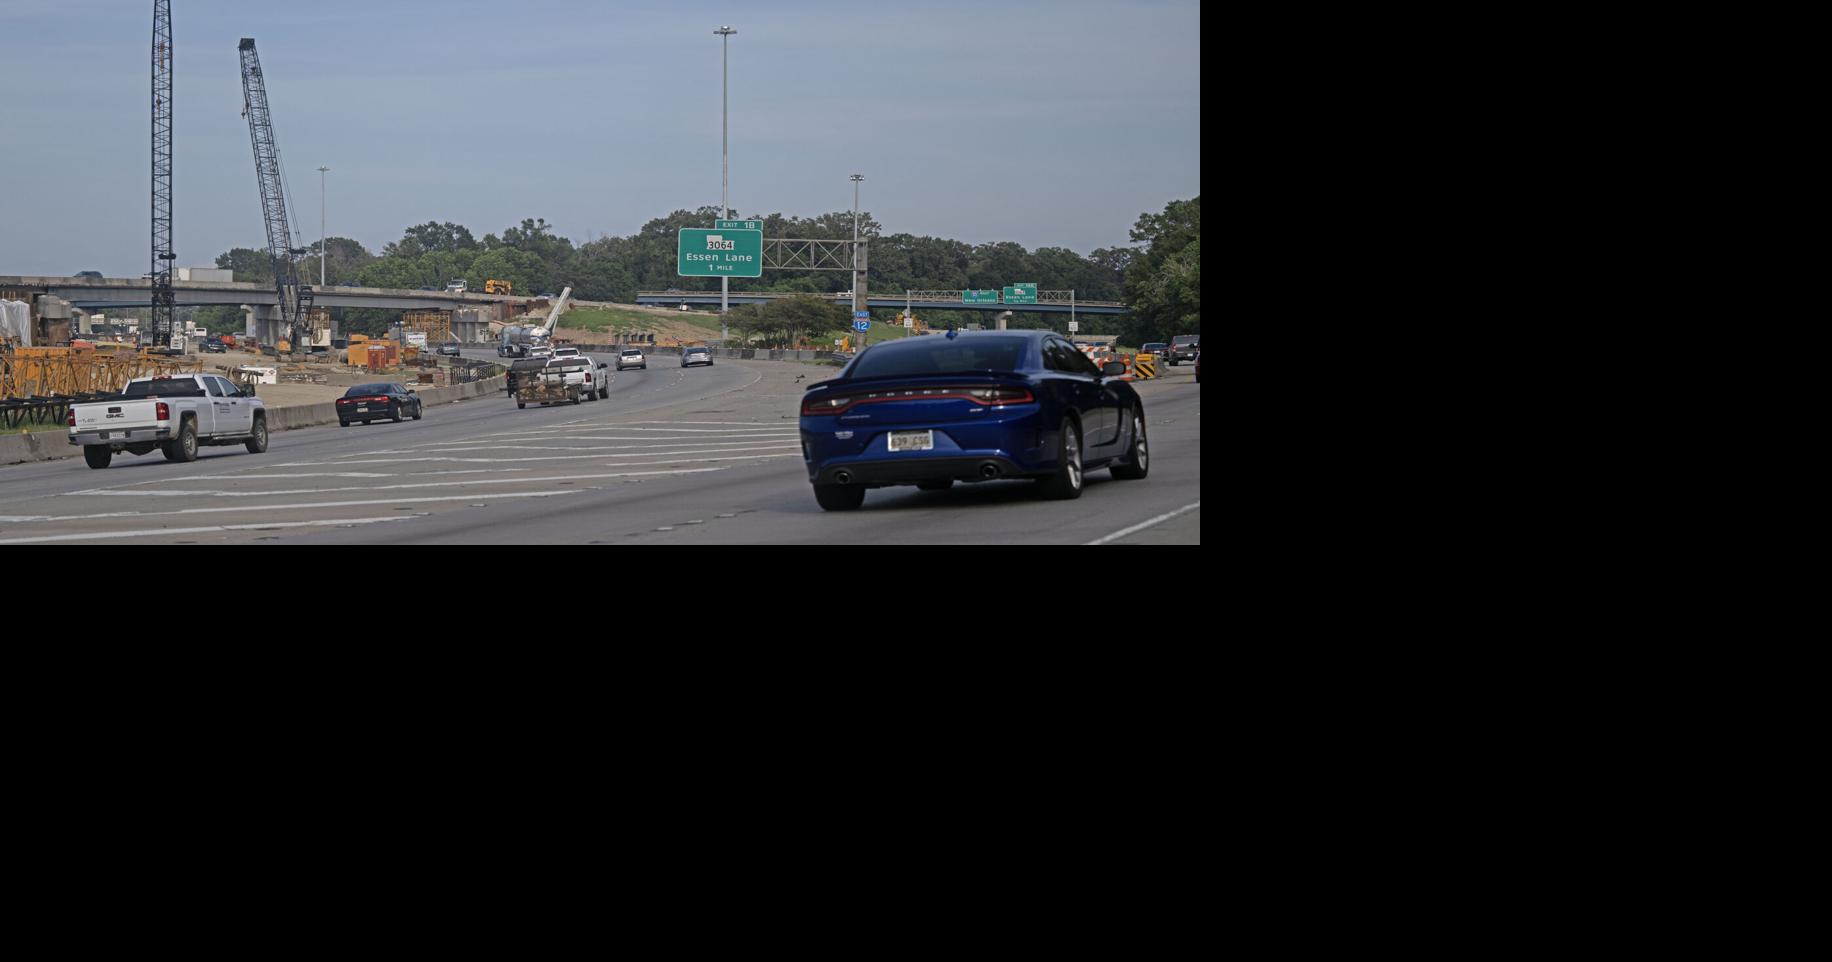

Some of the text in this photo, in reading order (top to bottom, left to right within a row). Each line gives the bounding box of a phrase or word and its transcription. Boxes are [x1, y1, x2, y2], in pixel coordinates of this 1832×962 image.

[744, 221, 755, 229] 1B
[708, 241, 733, 249] 3064
[686, 253, 753, 262] Essen Lane
[857, 321, 868, 330] 12
